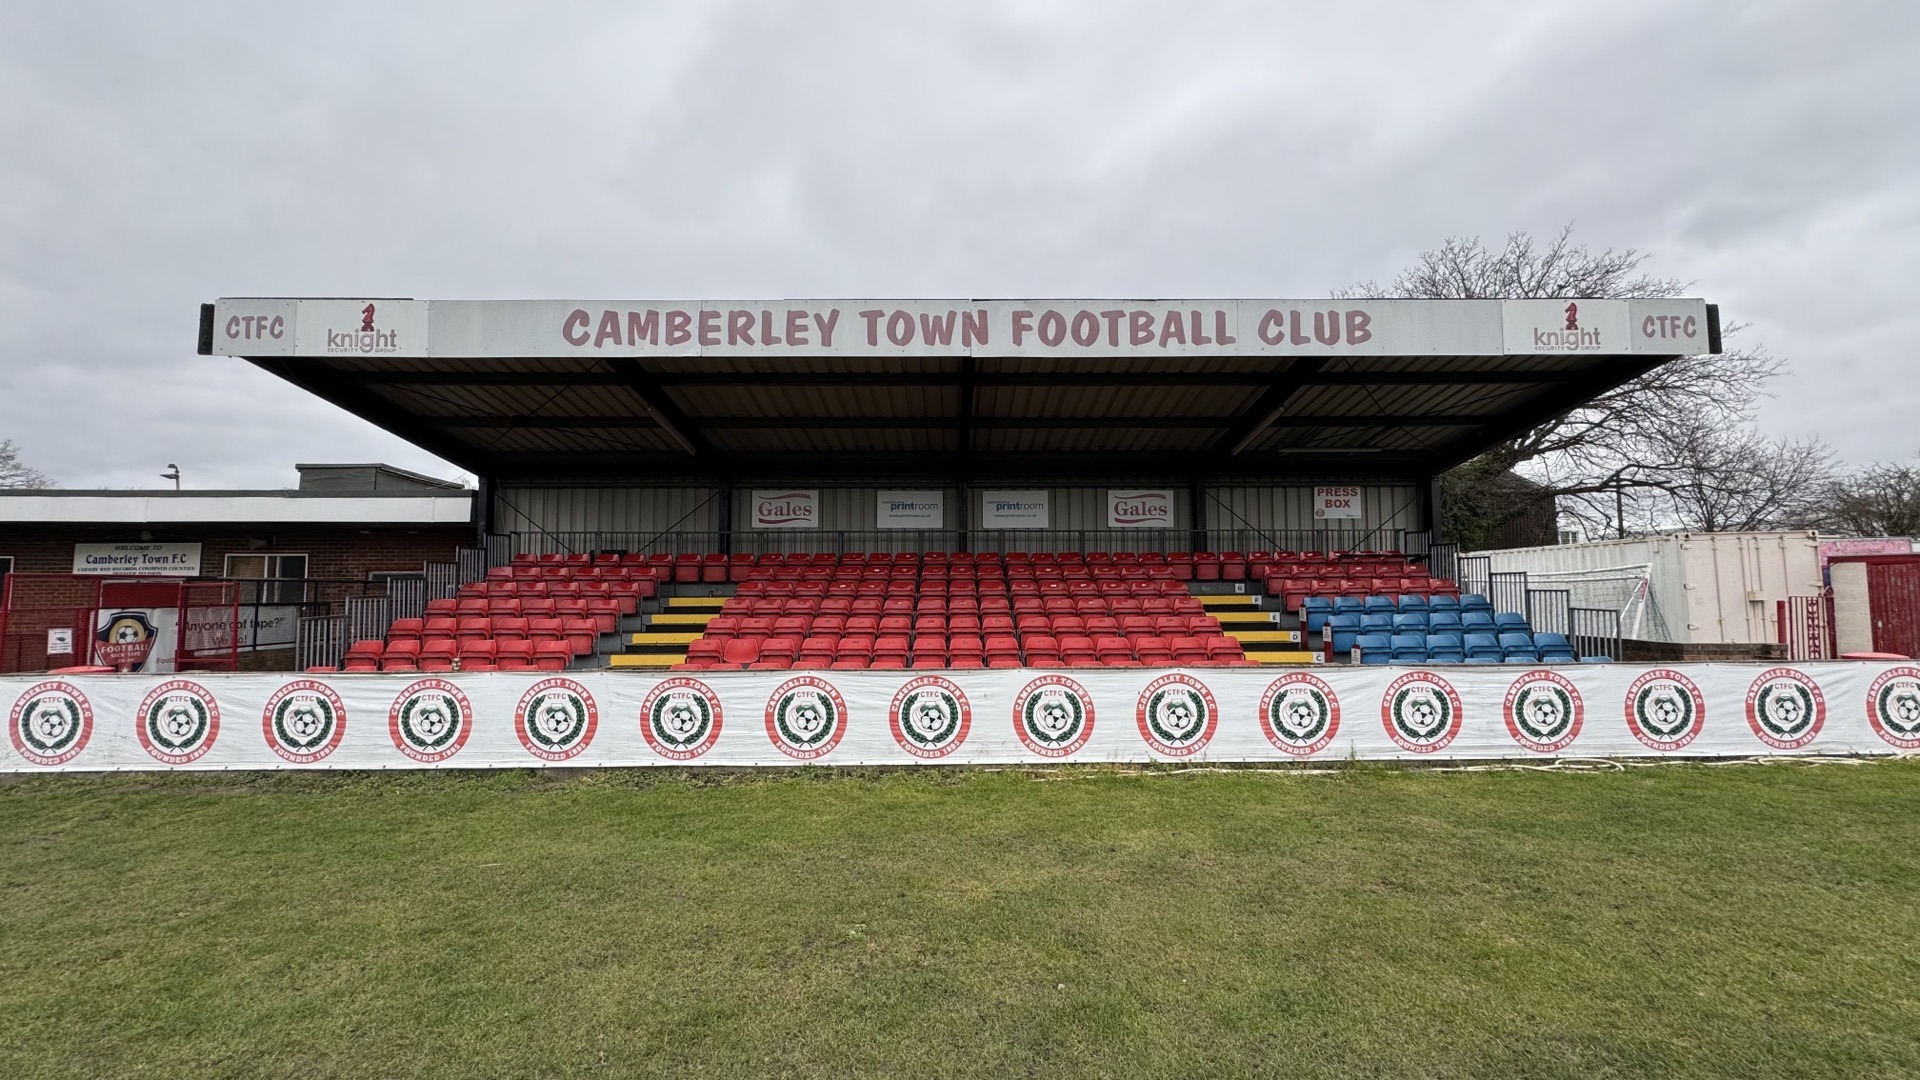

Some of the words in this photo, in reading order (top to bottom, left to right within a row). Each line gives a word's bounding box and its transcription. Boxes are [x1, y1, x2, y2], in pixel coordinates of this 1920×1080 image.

[226, 315, 284, 340] CTFC
[562, 308, 840, 348] CAMBERLEY
[858, 310, 988, 348] TOWN
[1011, 309, 1236, 348] FOOTBALL
[1257, 309, 1372, 347] CLUB
[1642, 315, 1697, 338] CTFC
[328, 328, 397, 353] knight
[1534, 328, 1600, 351] knight
[1317, 487, 1358, 497] PRESS
[758, 501, 812, 517] Gales
[890, 501, 938, 511] printroom
[996, 501, 1044, 511] printroom
[1114, 501, 1167, 516] Gales
[1325, 499, 1351, 508] BOX
[86, 554, 138, 566] Camberley
[142, 554, 168, 564] Town
[171, 553, 187, 564] F.C
[101, 644, 149, 653] FOOTBALL
[212, 637, 228, 646] We
[1015, 676, 1058, 710] CAMBERLEY
[1061, 678, 1085, 696] TOWN
[1138, 675, 1181, 710] CAMBERLEY
[1184, 677, 1208, 695] TOWN
[1261, 674, 1303, 709] CAMBERLEY
[1306, 676, 1330, 694] TOWN
[1383, 673, 1425, 707] CAMBERLEY
[1428, 675, 1452, 693] TOWN
[1505, 672, 1546, 707] CAMBERLEY
[1549, 674, 1574, 691] TOWN
[1626, 671, 1667, 705] CAMBERLEY
[1670, 672, 1694, 690] TOWN
[1747, 670, 1787, 704] CAMBERLEY
[1790, 671, 1815, 689] TOWN
[1868, 668, 1909, 702] CAMBERLEY
[11, 683, 58, 718] CAMBERLEY
[60, 684, 85, 702] TOWN
[138, 682, 184, 717] CAMBERLEY
[187, 683, 211, 702] TOWN
[265, 682, 310, 716] CAMBERLEY
[313, 683, 337, 702] TOWN
[391, 681, 436, 716] CAMBERLEY
[439, 682, 464, 700] TOWN
[517, 679, 562, 714] CAMBERLEY
[564, 681, 589, 699] TOWN
[642, 679, 686, 713] CAMBERLEY
[689, 680, 714, 699] TOWN
[767, 678, 811, 712] CAMBERLEY
[813, 679, 838, 697] TOWN
[891, 677, 934, 712] CAMBERLEY
[937, 679, 962, 697] TOWN
[1025, 739, 1064, 756] FOUNDED
[1067, 739, 1084, 752] 1895
[1148, 738, 1188, 755] FOUNDED
[1191, 737, 1208, 751] 1895
[1271, 737, 1311, 753] FOUNDED
[1314, 736, 1331, 750] 1895
[1394, 735, 1433, 752] FOUNDED
[1436, 735, 1453, 748] 1895
[1516, 735, 1556, 751] FOUNDED
[1558, 733, 1575, 747] 1895
[1638, 733, 1677, 749] FOUNDED
[1758, 732, 1798, 748] FOUNDED
[1879, 730, 1919, 747] FOUNDED
[19, 747, 59, 764] FOUNDED
[147, 746, 187, 762] FOUNDED
[273, 745, 313, 762] FOUNDED
[316, 744, 334, 758] 1895
[400, 744, 440, 761] FOUNDED
[443, 743, 461, 757] 1895
[526, 743, 566, 759] FOUNDED
[569, 742, 587, 756] 1895
[651, 742, 691, 758] FOUNDED
[694, 741, 712, 755] 1895
[776, 741, 816, 758] FOUNDED
[819, 740, 836, 754] 1895
[901, 740, 940, 757] FOUNDED
[944, 739, 961, 753] 1895
